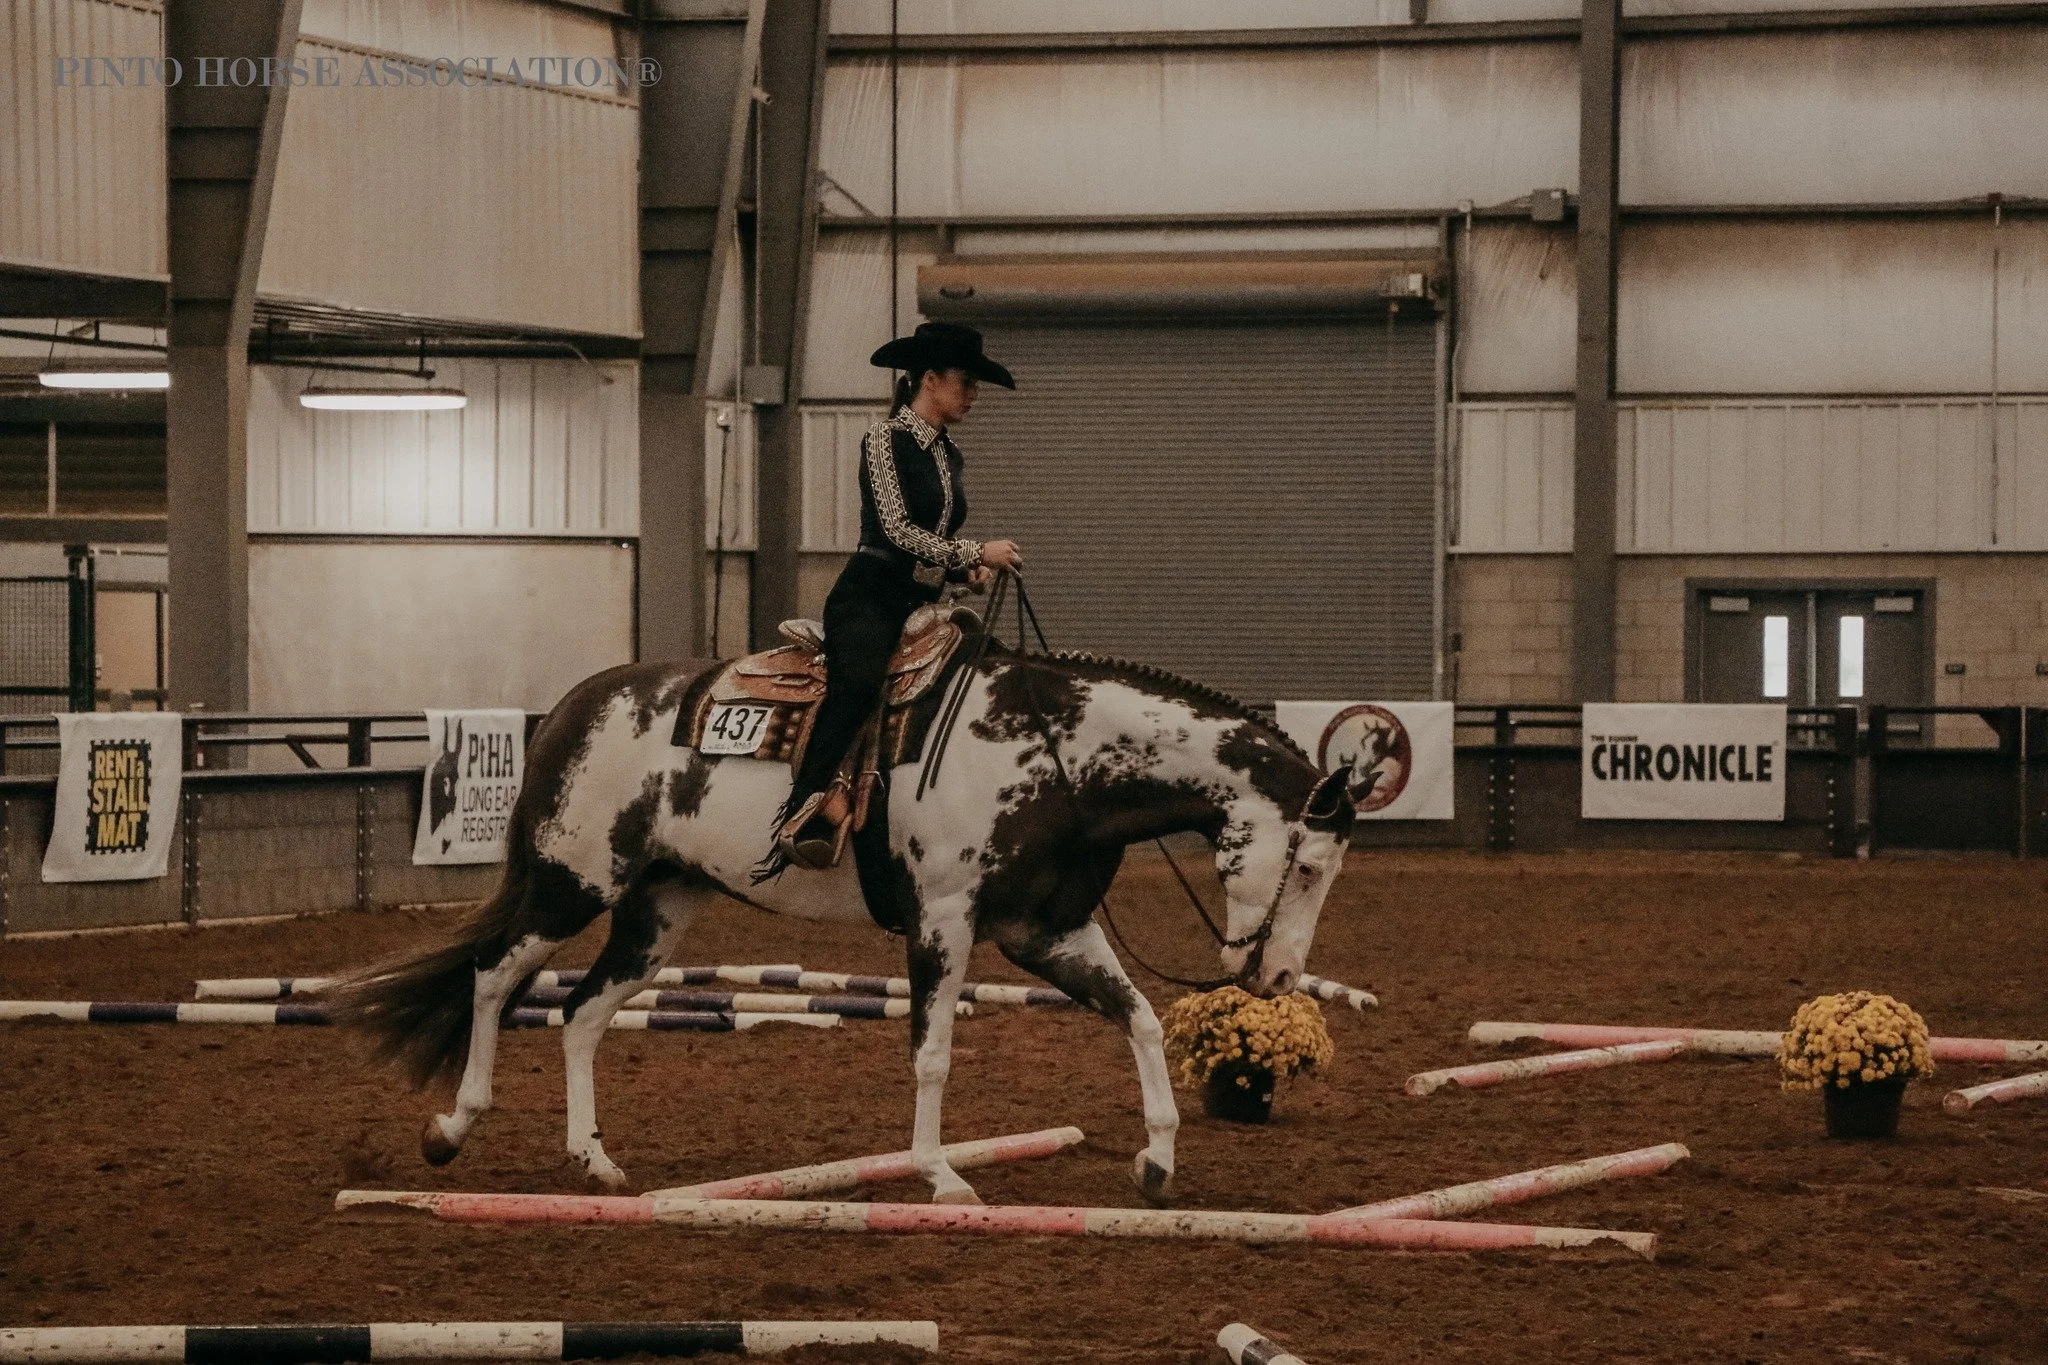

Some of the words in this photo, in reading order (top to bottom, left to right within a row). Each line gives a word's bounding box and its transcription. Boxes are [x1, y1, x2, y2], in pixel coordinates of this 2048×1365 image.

[711, 707, 768, 741] 437
[95, 750, 138, 779] RENT
[1591, 744, 1772, 782] CHRONICLE
[92, 779, 147, 813] STALL
[97, 813, 141, 847] MAT
